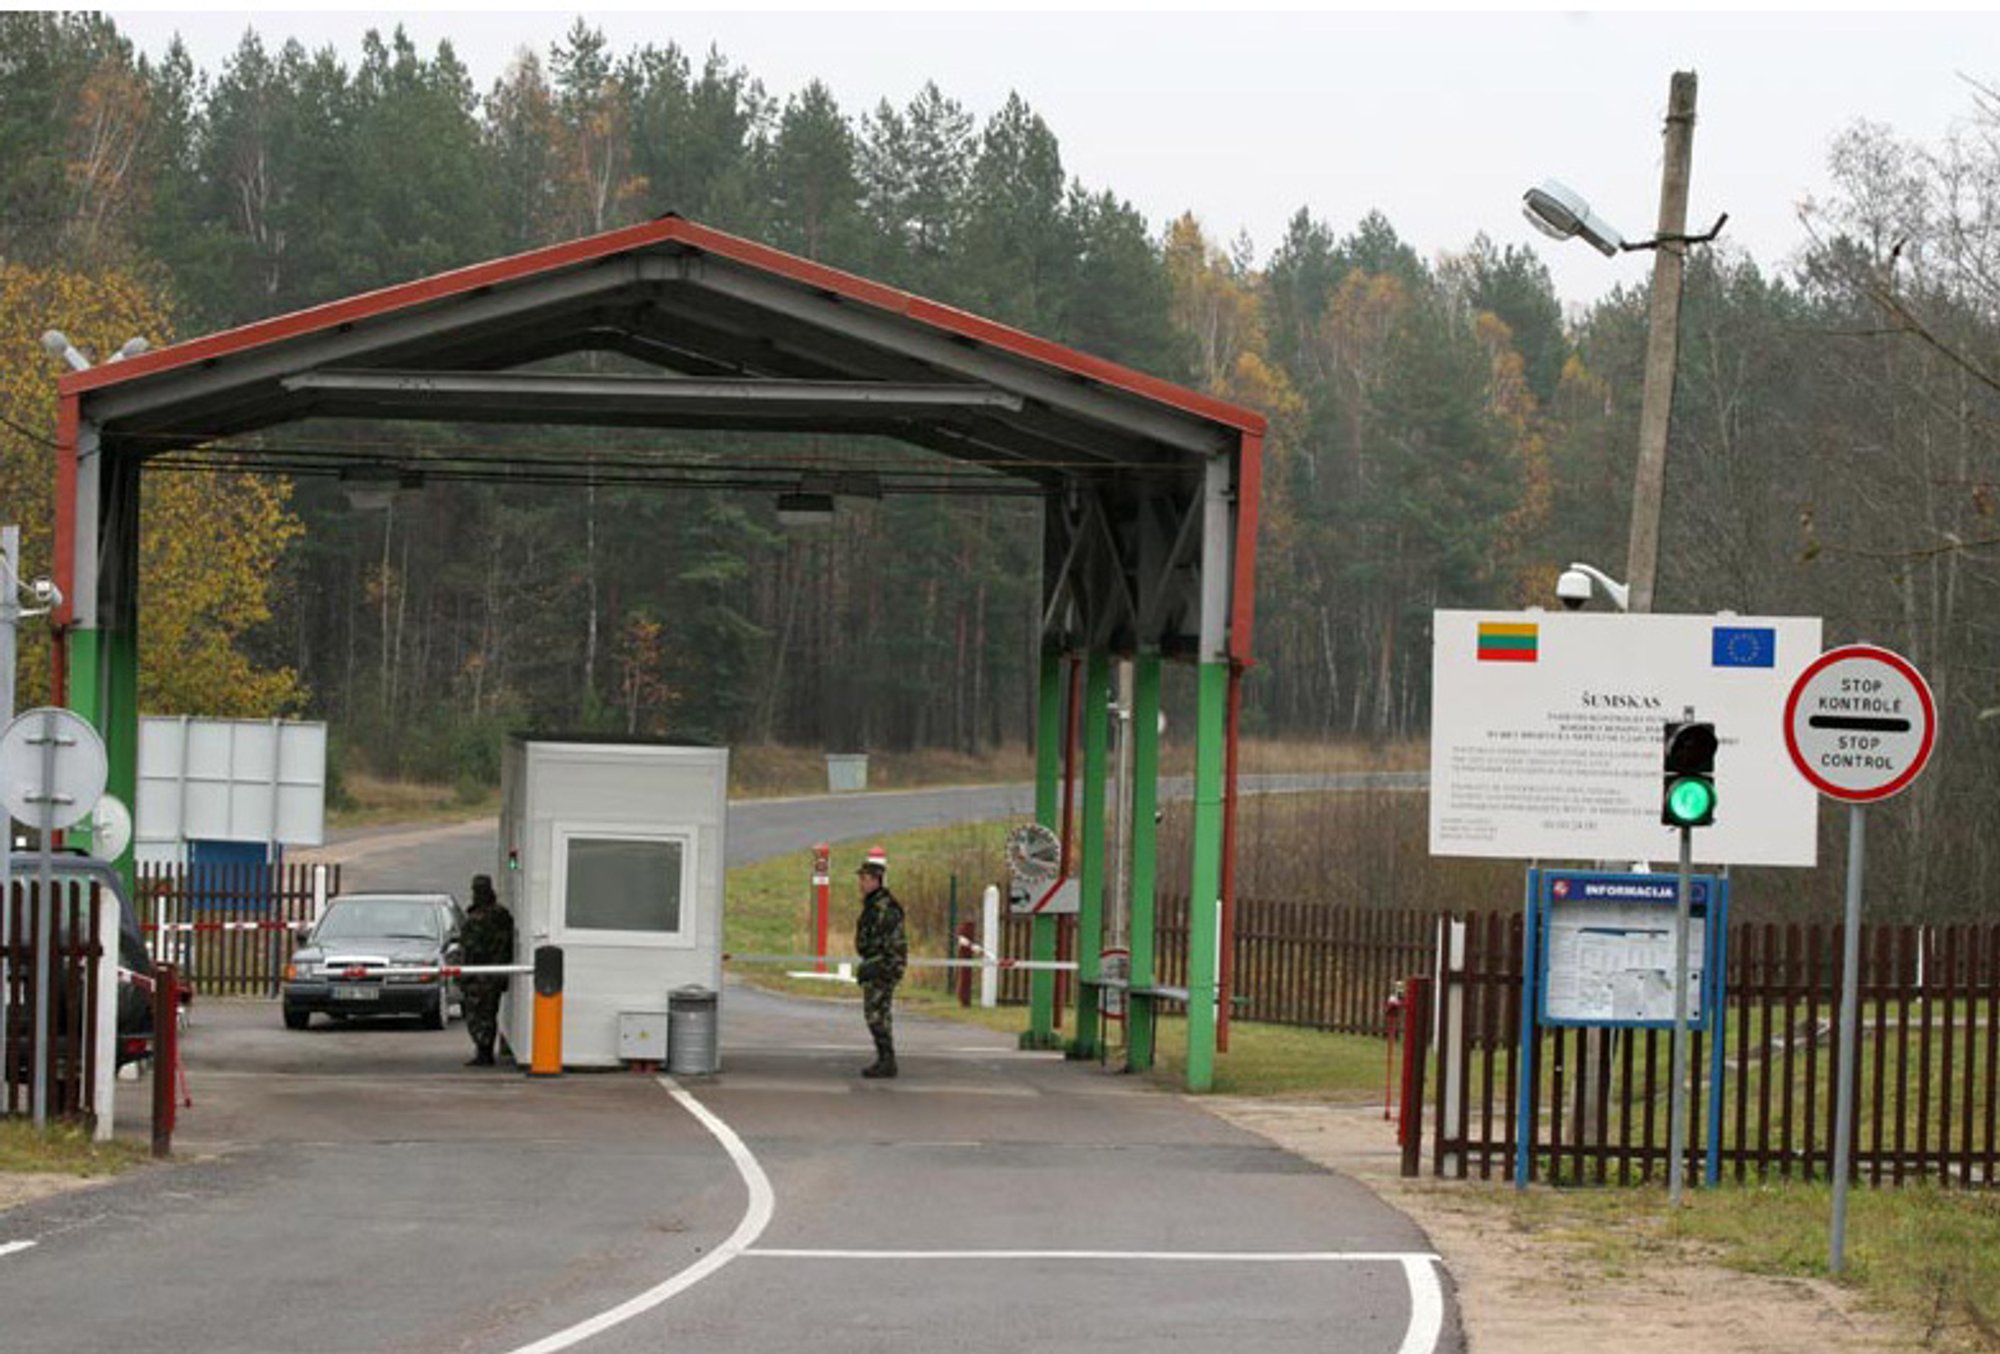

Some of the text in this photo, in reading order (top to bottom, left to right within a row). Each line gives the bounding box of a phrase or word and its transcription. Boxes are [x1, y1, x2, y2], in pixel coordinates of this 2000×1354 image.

[1842, 679, 1882, 693] STOP
[1581, 691, 1662, 708] ŠUMSKAS
[1839, 736, 1881, 750] STOP
[1821, 754, 1894, 770] CONTROL
[1585, 884, 1674, 898] INFORMACIJA
